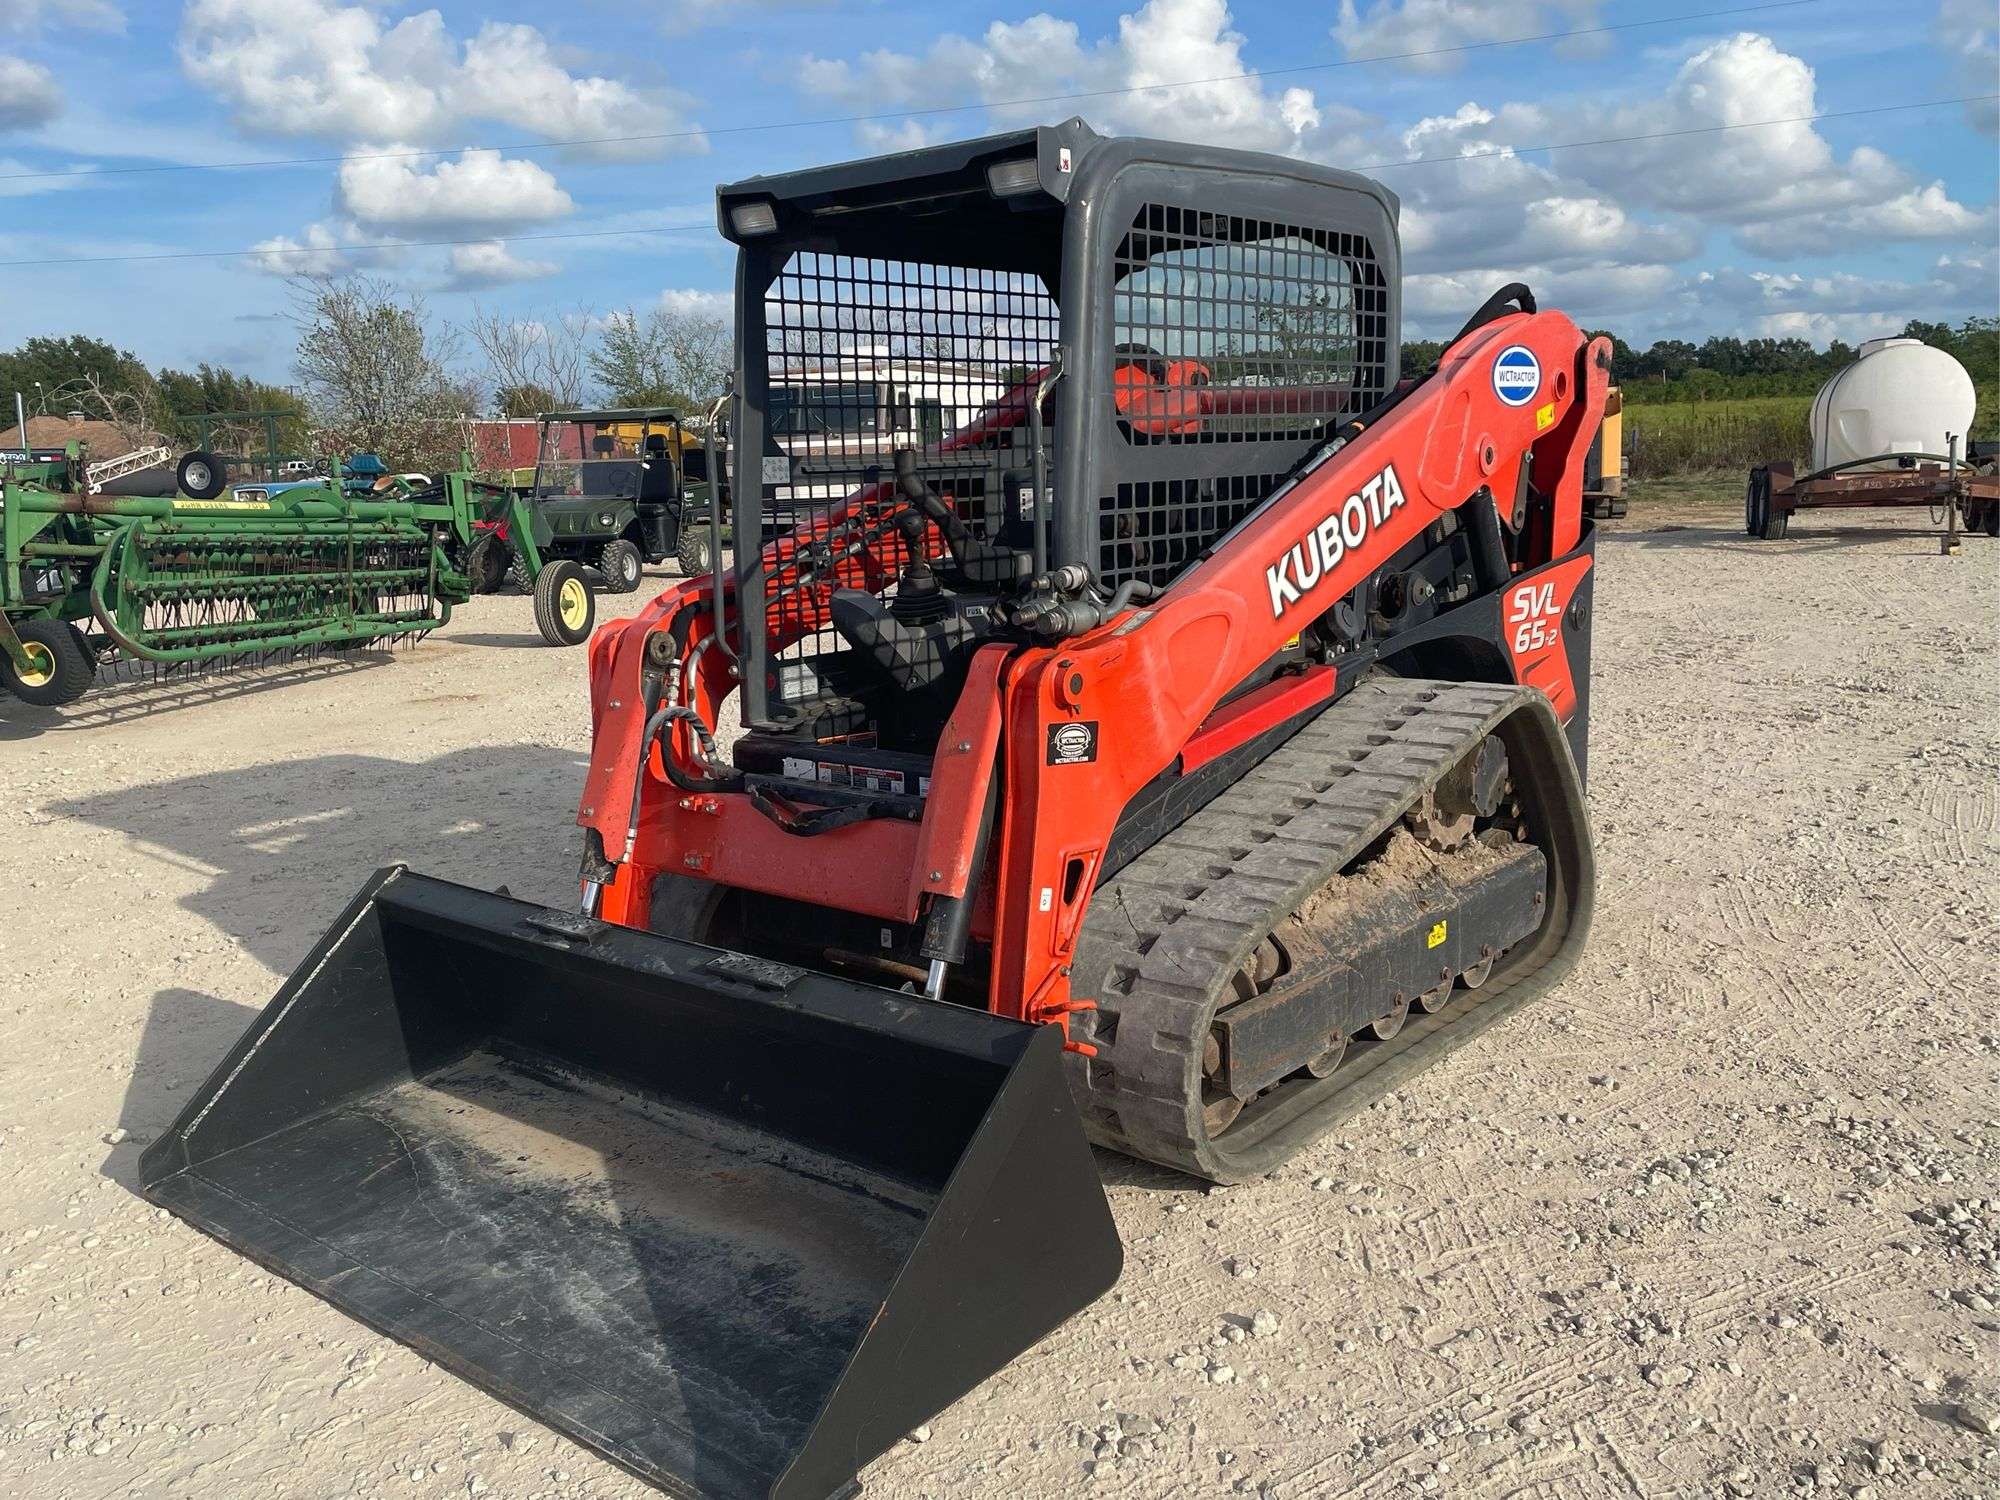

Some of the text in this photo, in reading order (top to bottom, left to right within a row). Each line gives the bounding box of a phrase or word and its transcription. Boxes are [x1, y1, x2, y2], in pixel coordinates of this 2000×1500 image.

[1266, 464, 1406, 619] KUBOTA
[1510, 582, 1561, 623] SVL
[1515, 619, 1558, 653] 65-2
